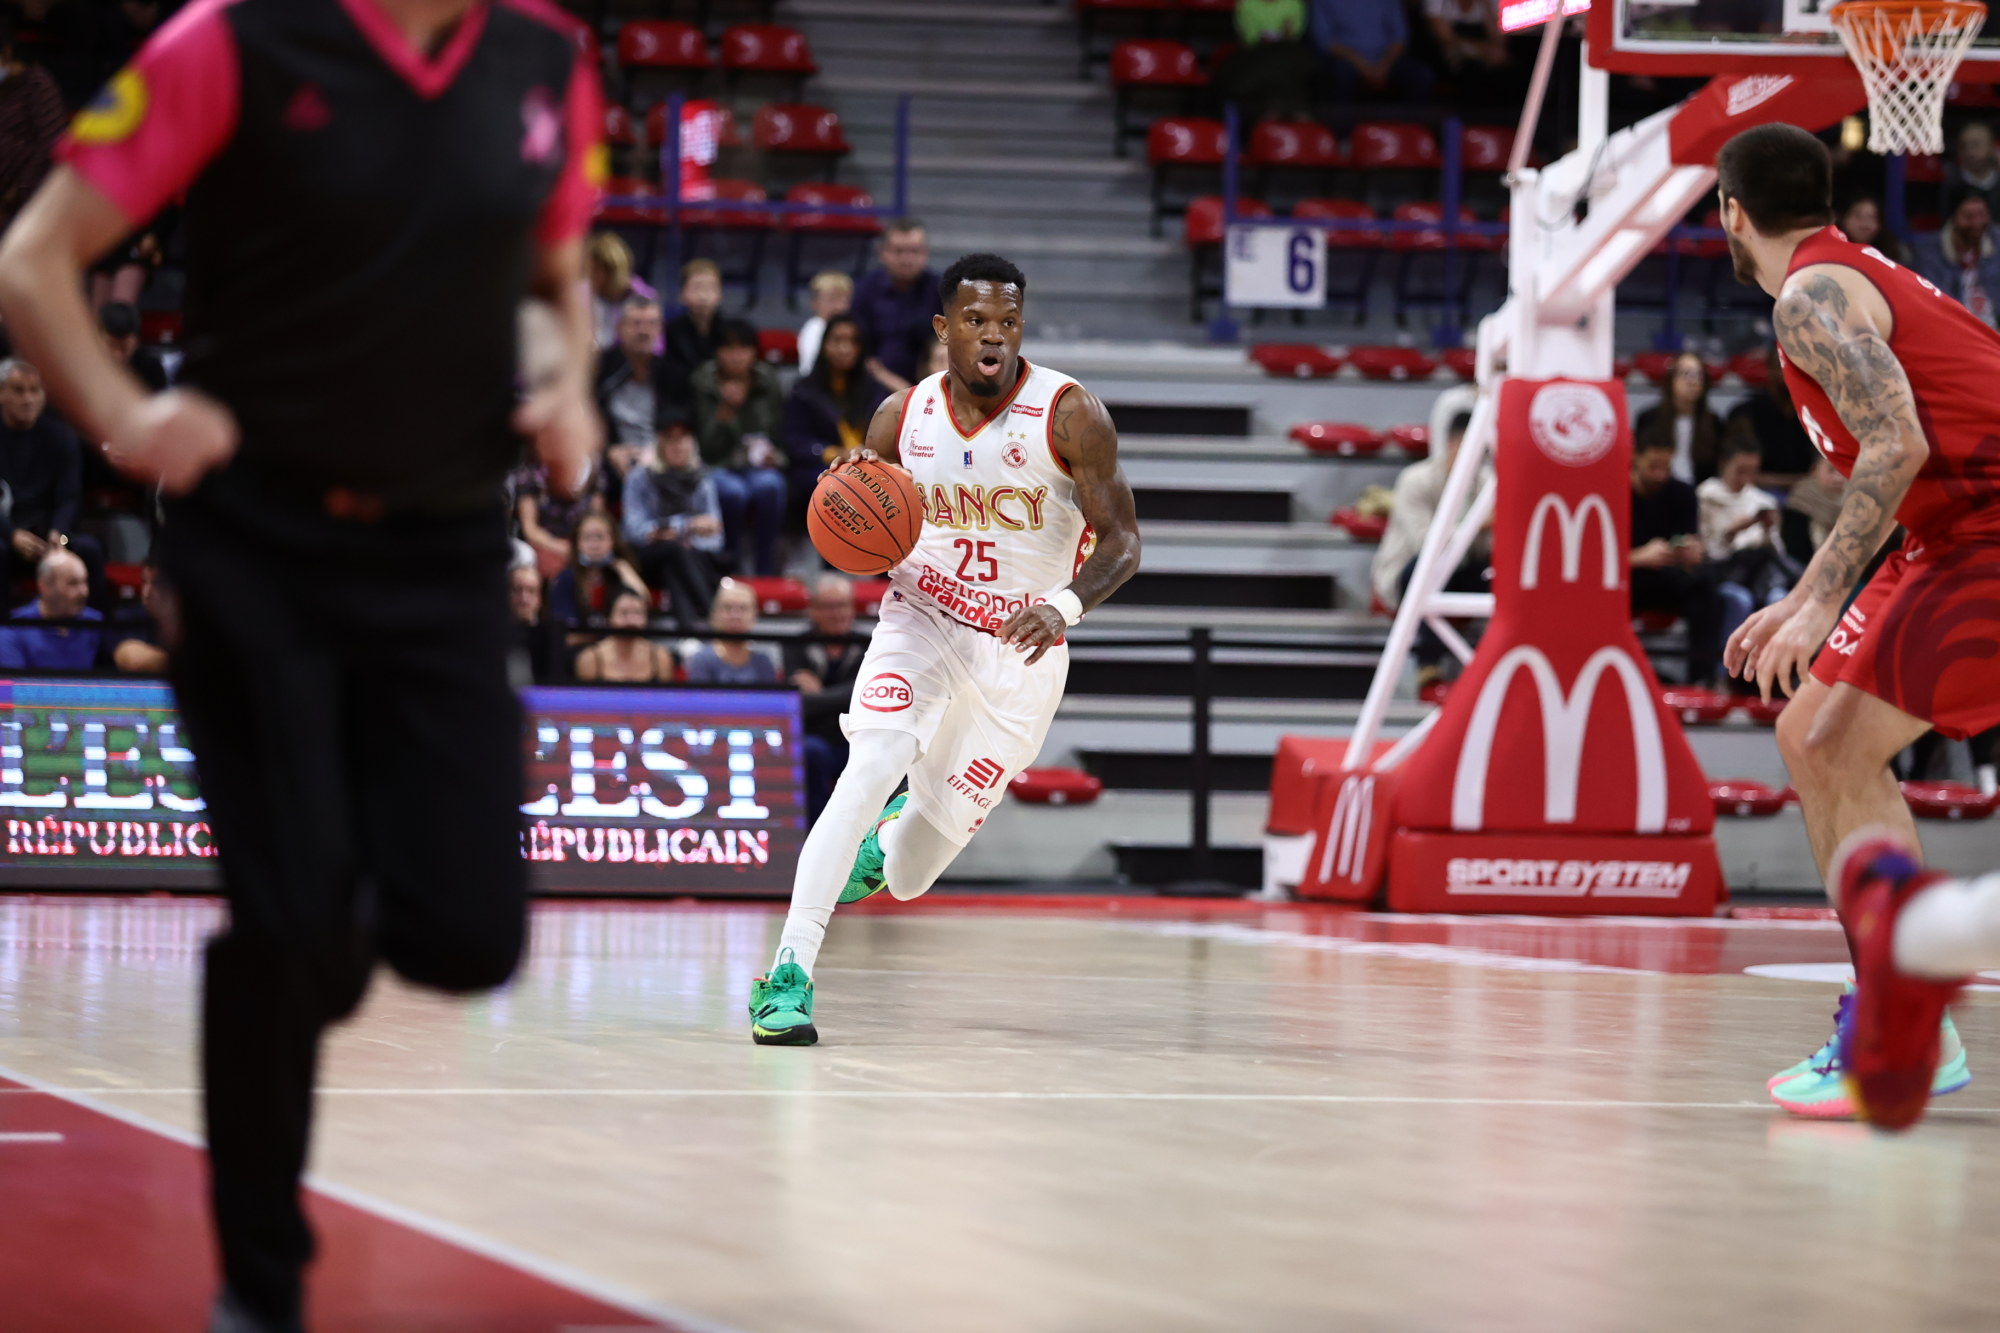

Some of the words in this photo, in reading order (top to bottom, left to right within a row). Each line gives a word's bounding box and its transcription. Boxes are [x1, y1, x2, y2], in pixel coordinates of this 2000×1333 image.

[1289, 228, 1315, 294] 6
[825, 485, 875, 532] LEGACY
[842, 464, 900, 521] SPALDING
[953, 538, 998, 582] 25
[917, 574, 1006, 631] GrandNa
[862, 685, 910, 702] cora
[5, 815, 219, 857] RÉPUBLIC
[520, 820, 770, 864] ÉPUBLICAIN
